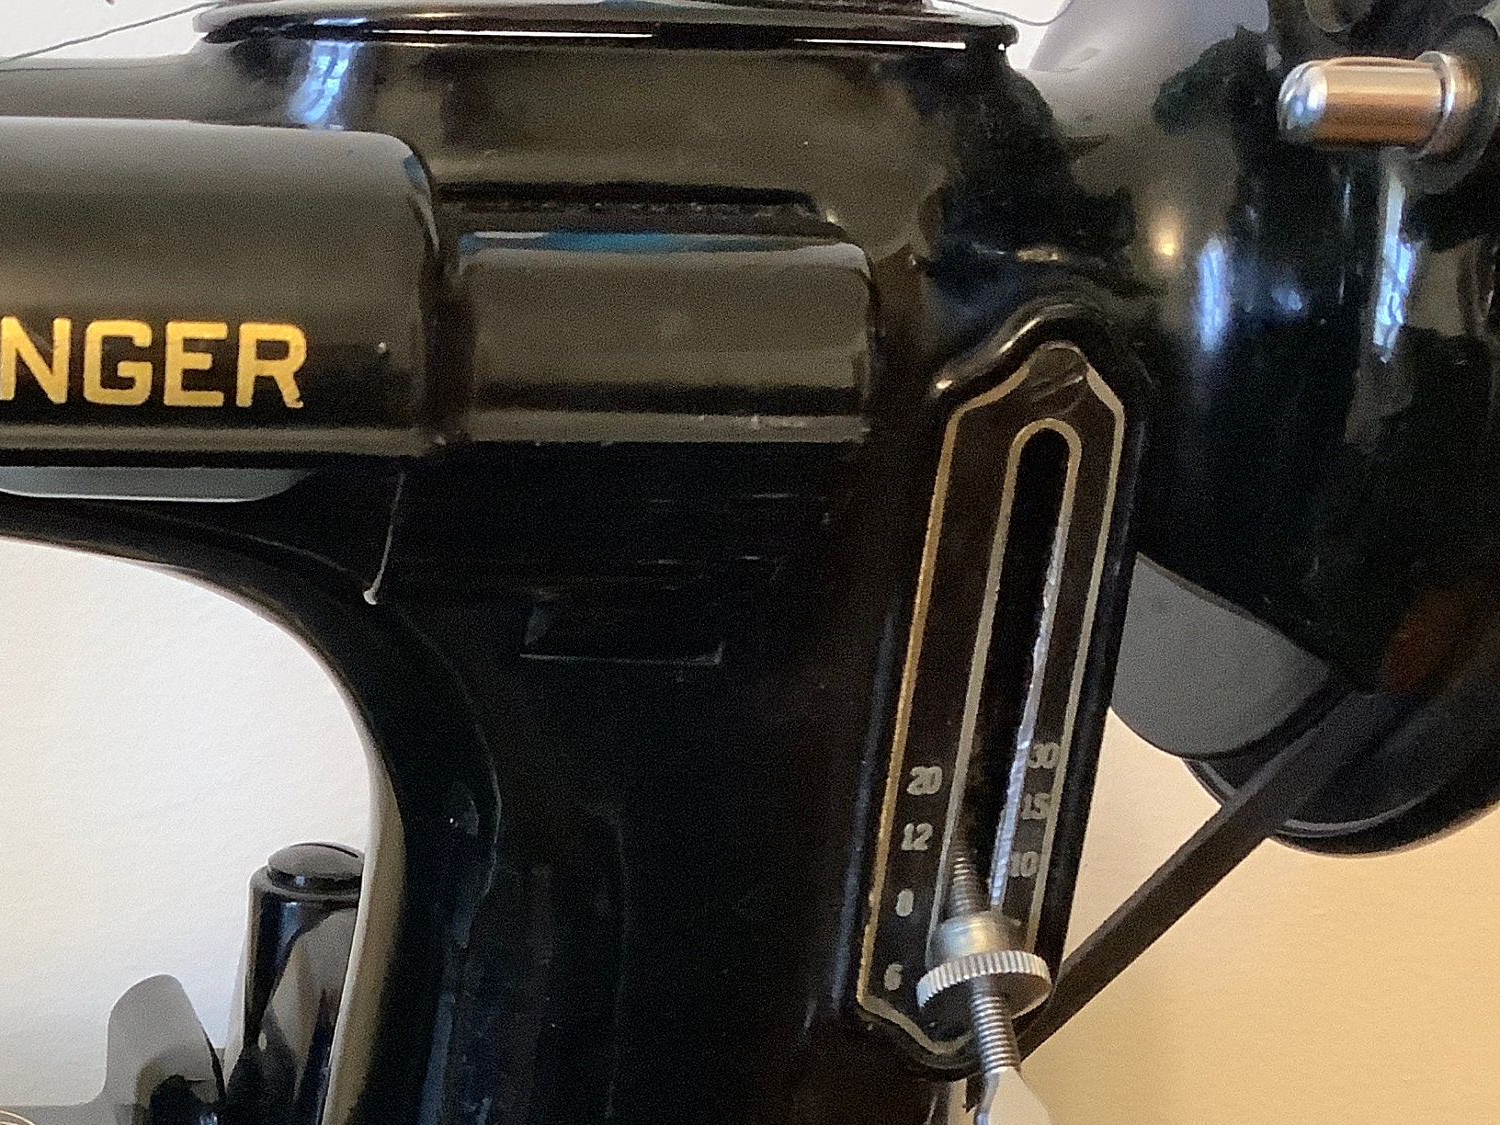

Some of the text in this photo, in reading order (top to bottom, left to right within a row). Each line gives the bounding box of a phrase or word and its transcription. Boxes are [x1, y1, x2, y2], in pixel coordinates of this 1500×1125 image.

[906, 765, 943, 795] 20
[1022, 792, 1051, 820] 15
[901, 822, 933, 851] 12
[884, 962, 903, 991] 6
